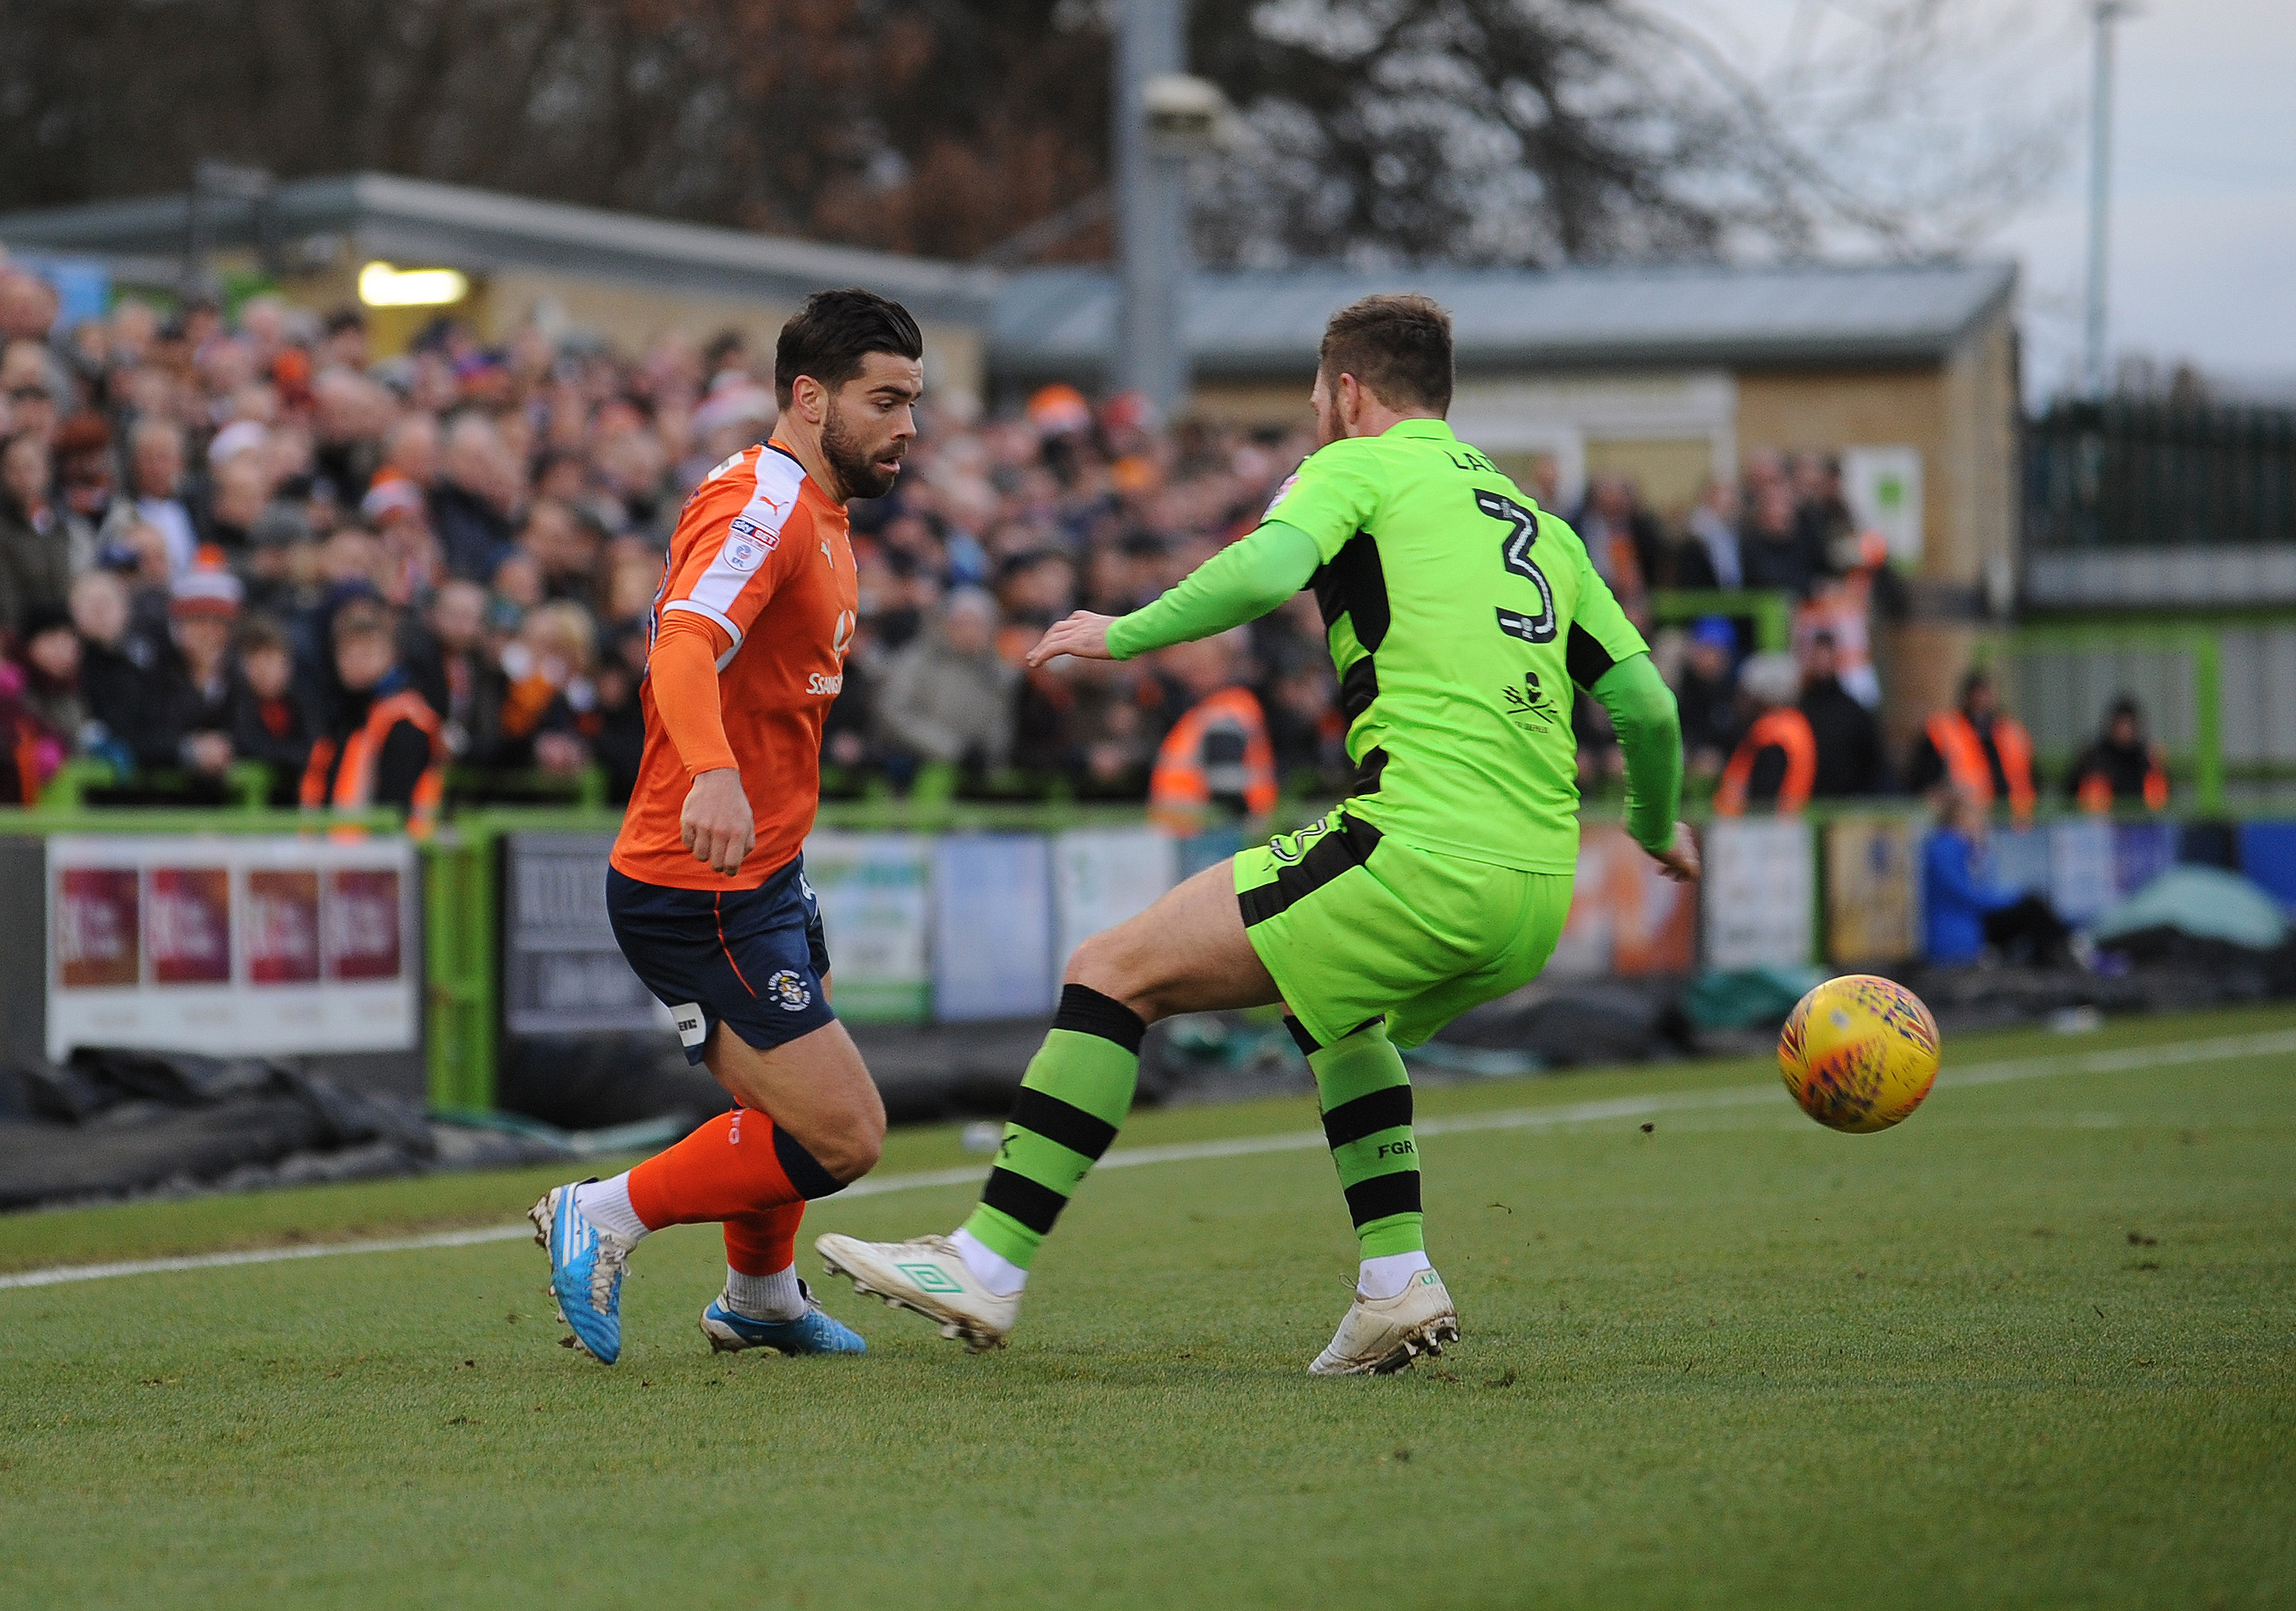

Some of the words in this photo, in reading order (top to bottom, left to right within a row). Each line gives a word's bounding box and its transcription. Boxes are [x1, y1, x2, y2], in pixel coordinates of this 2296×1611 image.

[1472, 488, 1557, 643] 3
[1270, 818, 1327, 863] 3
[1378, 1139, 1414, 1159] FGR
